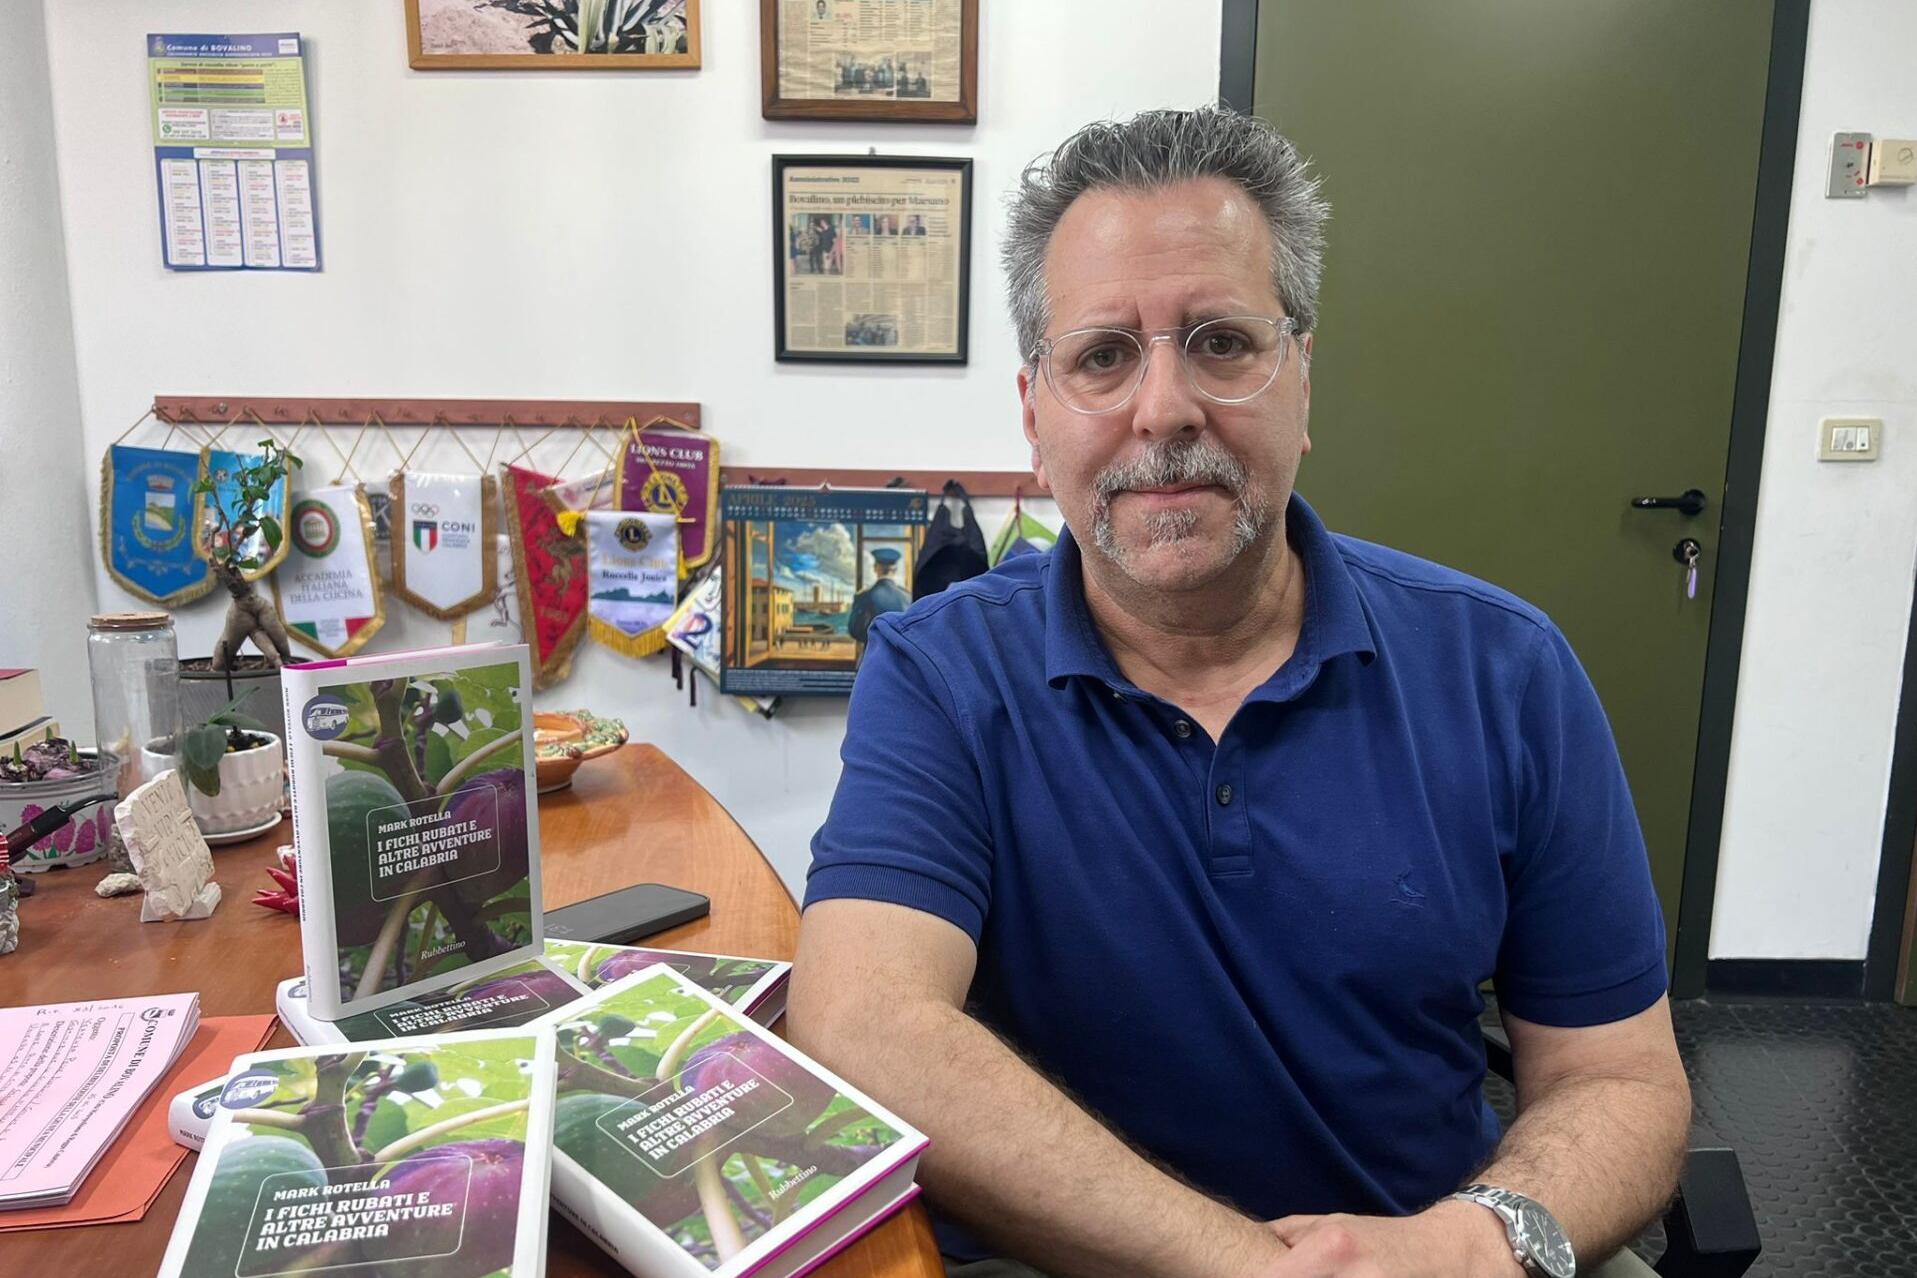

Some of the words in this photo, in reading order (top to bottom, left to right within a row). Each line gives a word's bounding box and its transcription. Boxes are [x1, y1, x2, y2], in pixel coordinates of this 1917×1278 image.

[630, 443, 668, 457] LIONS
[669, 447, 704, 461] CLUB
[441, 520, 476, 533] CONI
[295, 570, 353, 582] ACCADEMIA
[301, 580, 349, 592] ITALIANA
[289, 592, 320, 604] DELLA
[322, 589, 364, 601] CUCINA
[377, 841, 383, 853] I
[385, 833, 420, 851] FICHI
[422, 822, 468, 842] RUBATI
[469, 820, 477, 832] E
[378, 820, 408, 834] MARK
[409, 810, 452, 828] ROTELLA
[378, 846, 420, 865] ALTRE
[421, 828, 492, 855] AVVENTURE
[379, 865, 394, 878] IN
[395, 849, 459, 874] CALABRIA
[420, 940, 467, 960] Rubbettino
[389, 1008, 421, 1017] MARK
[396, 1013, 446, 1028] ALTRE
[445, 994, 529, 1016] AVVENTURE
[400, 1024, 418, 1032] IN
[419, 1008, 493, 1028] CALABRIA
[401, 1009, 441, 1021] FICHI
[441, 997, 497, 1012] RUBATI
[104, 1027, 125, 1059] PROPOSTA
[134, 1020, 159, 1058] COMUNE
[103, 1068, 136, 1098] BOVALINO
[617, 1109, 651, 1131] MARK
[648, 1085, 696, 1113] ROTELLA
[627, 1134, 639, 1144] I
[636, 1112, 678, 1139] FICHI
[672, 1085, 725, 1118] RUBATI
[721, 1079, 735, 1092] E
[639, 1120, 687, 1152] ALTRE
[682, 1077, 760, 1126] AVVENTURE
[648, 1146, 670, 1160] IN
[666, 1107, 735, 1150] CALABRIA
[273, 1186, 319, 1201] MARK
[322, 1179, 391, 1195] ROTELLA
[768, 1164, 818, 1201] Rubbettino
[260, 1216, 328, 1236] ALTRE
[330, 1202, 454, 1228] AVVENTURE
[264, 1208, 274, 1221] I
[276, 1201, 333, 1220] FICHI
[336, 1193, 415, 1213] RUBATI
[417, 1191, 431, 1205] E
[256, 1235, 281, 1251] IN
[283, 1223, 390, 1249] CALABRIA
